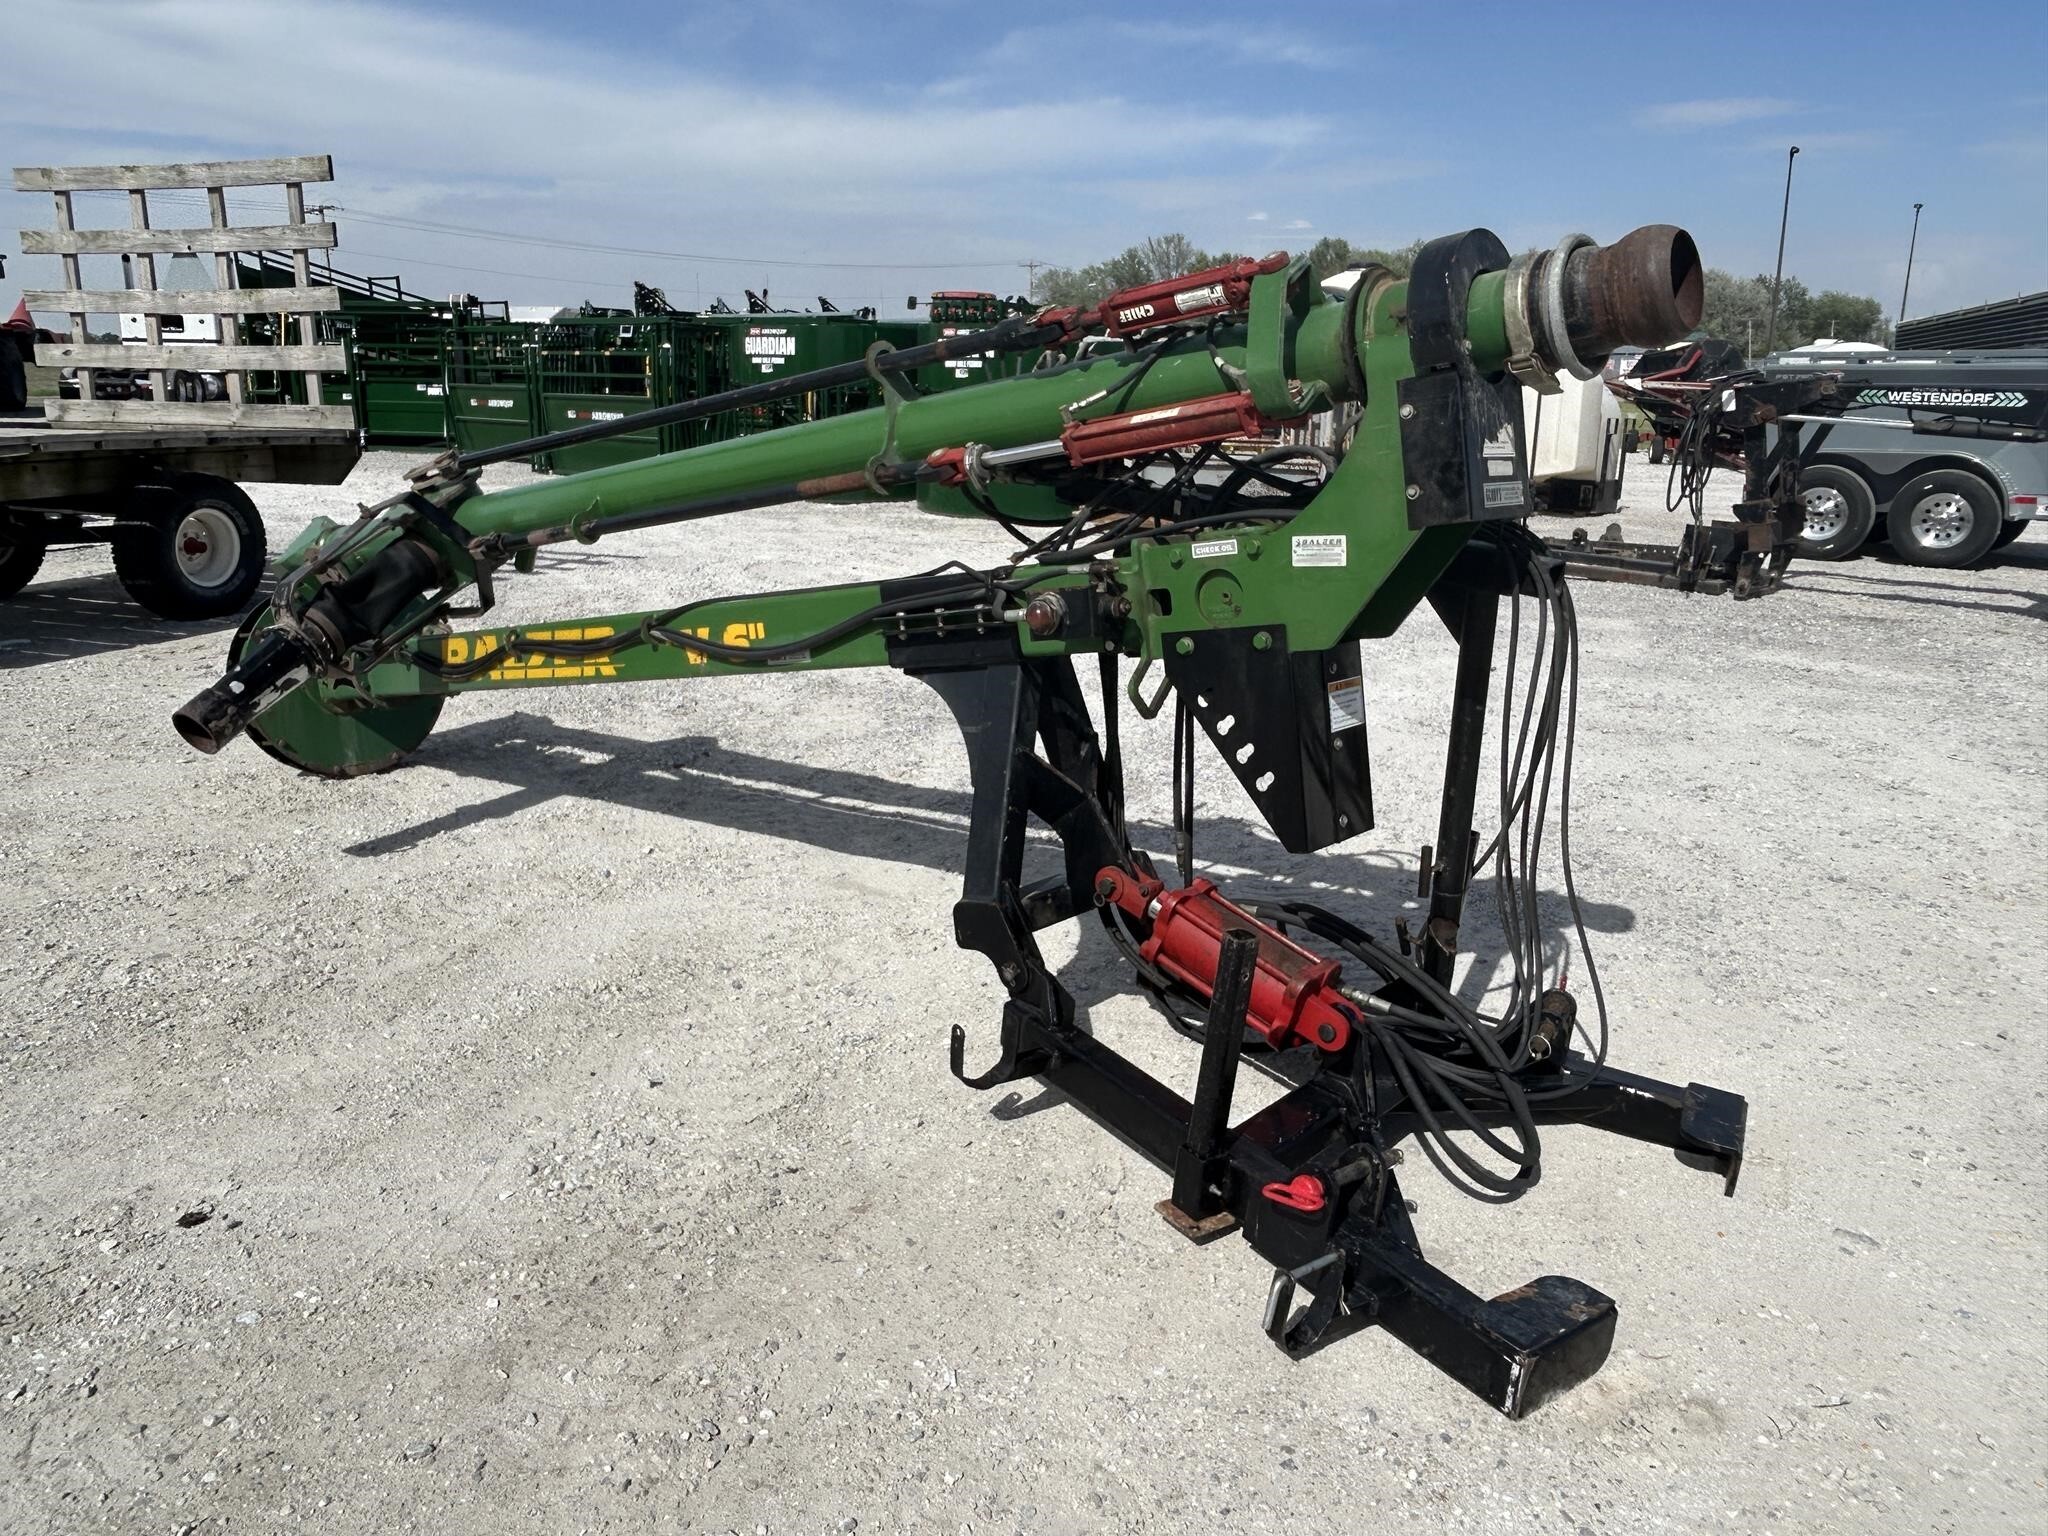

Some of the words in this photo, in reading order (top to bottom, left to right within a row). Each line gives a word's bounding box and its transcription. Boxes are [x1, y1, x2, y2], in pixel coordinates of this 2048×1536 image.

[1120, 304, 1154, 322] CHIEF
[745, 336, 796, 356] GUARDIAN
[1888, 391, 1995, 404] WESTENDORF
[1302, 538, 1342, 546] BALZER
[1196, 545, 1220, 555] CHECK
[1221, 543, 1233, 552] OIL
